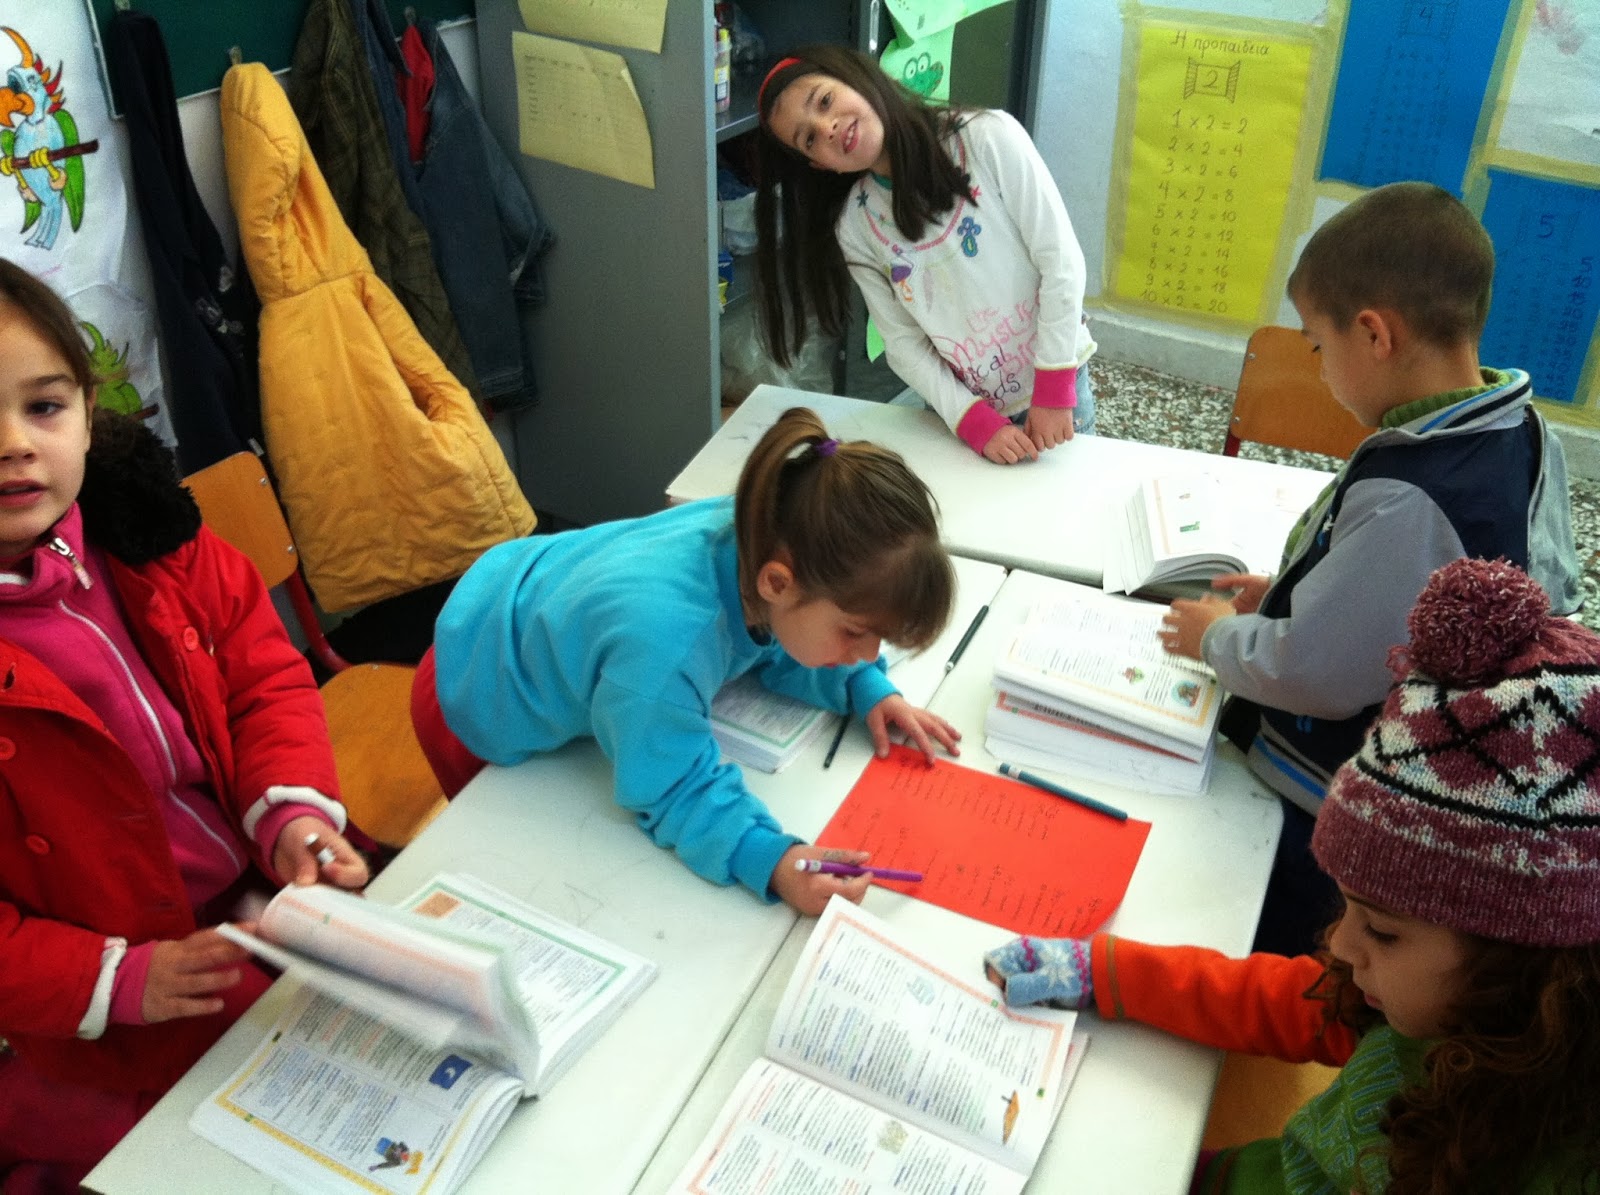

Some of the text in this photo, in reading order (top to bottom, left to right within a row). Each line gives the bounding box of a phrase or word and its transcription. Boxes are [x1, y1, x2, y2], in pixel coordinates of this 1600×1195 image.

[1202, 70, 1219, 89] 2
[1172, 108, 1181, 128] 1
[1206, 114, 1215, 130] 2
[1238, 117, 1248, 134] 2
[1168, 136, 1178, 152] 2
[1201, 141, 1210, 155] 2
[1233, 143, 1242, 157] 4
[1162, 157, 1174, 174] 3
[1200, 163, 1207, 176] 2
[1229, 165, 1238, 178] 6
[1159, 180, 1169, 199] 4
[1194, 186, 1205, 202] 2
[1225, 188, 1234, 202] 8
[1153, 203, 1166, 218] 5
[1190, 207, 1198, 220] 2
[1222, 209, 1237, 222] 10
[1152, 223, 1161, 236] 6
[1186, 226, 1195, 238] 2
[1218, 229, 1233, 243] 12
[1537, 214, 1555, 239] 5
[1184, 245, 1192, 256] 2
[1216, 247, 1229, 260] 14
[1149, 257, 1157, 269] 8
[1179, 262, 1187, 274] 2
[1214, 264, 1228, 278] 16
[1580, 256, 1593, 273] 5
[1145, 273, 1154, 286] 9
[1177, 280, 1185, 291] 2
[1212, 281, 1227, 294] 18
[1140, 289, 1157, 302] 10
[1176, 295, 1184, 307] 2
[1208, 299, 1228, 313] 20
